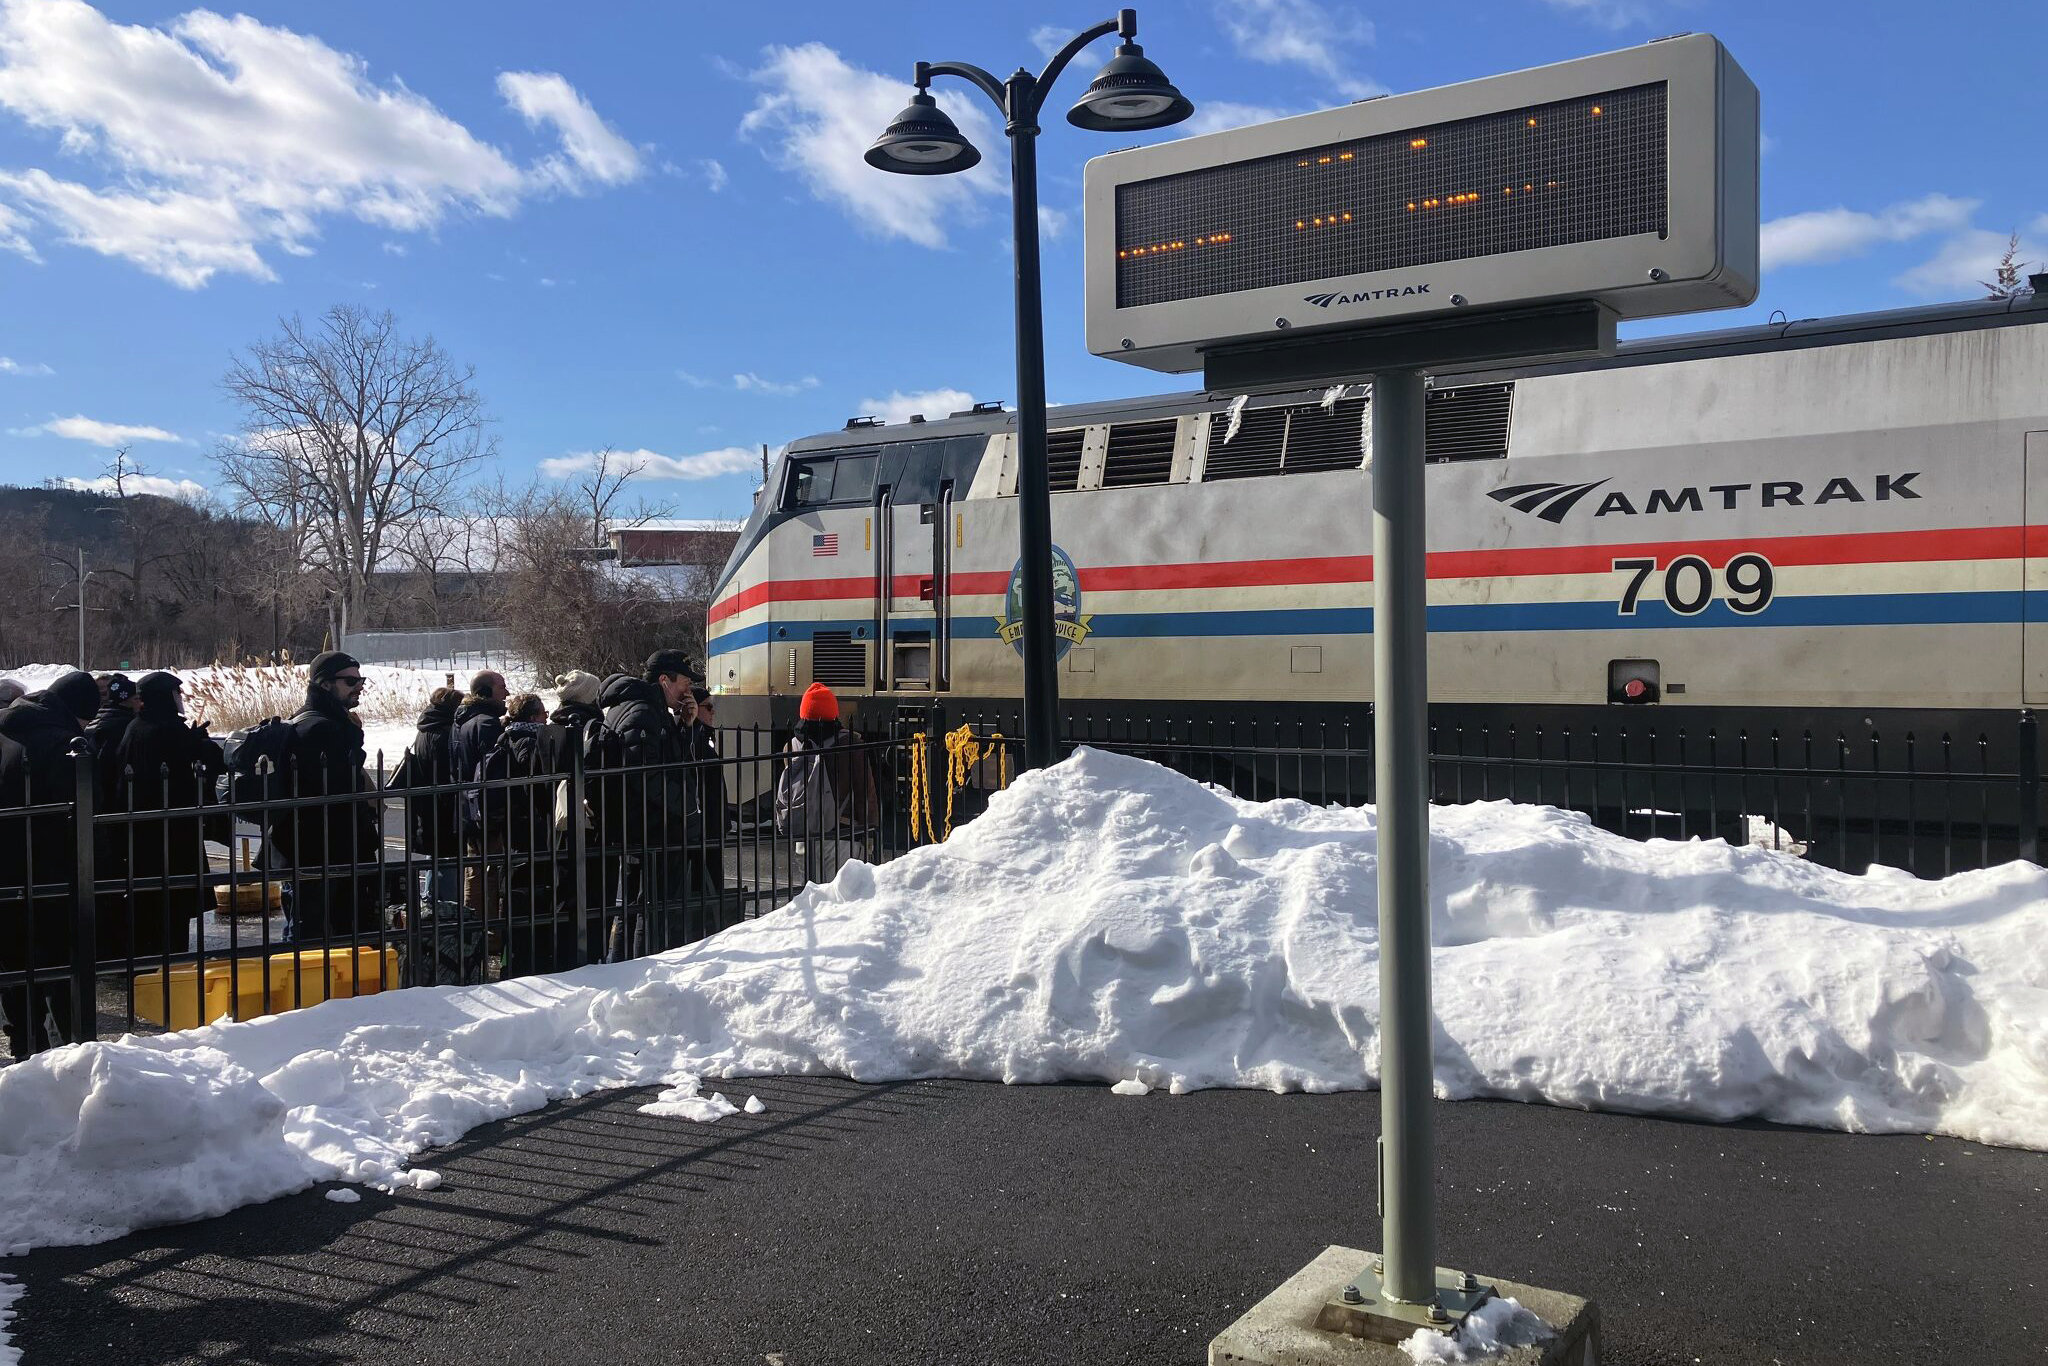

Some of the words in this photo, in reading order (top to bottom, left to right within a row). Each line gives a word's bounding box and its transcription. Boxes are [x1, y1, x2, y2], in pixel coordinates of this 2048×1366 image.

[1338, 283, 1431, 305] AMTRAK
[1594, 472, 1924, 517] AMTRAK
[1612, 552, 1775, 617] 709
